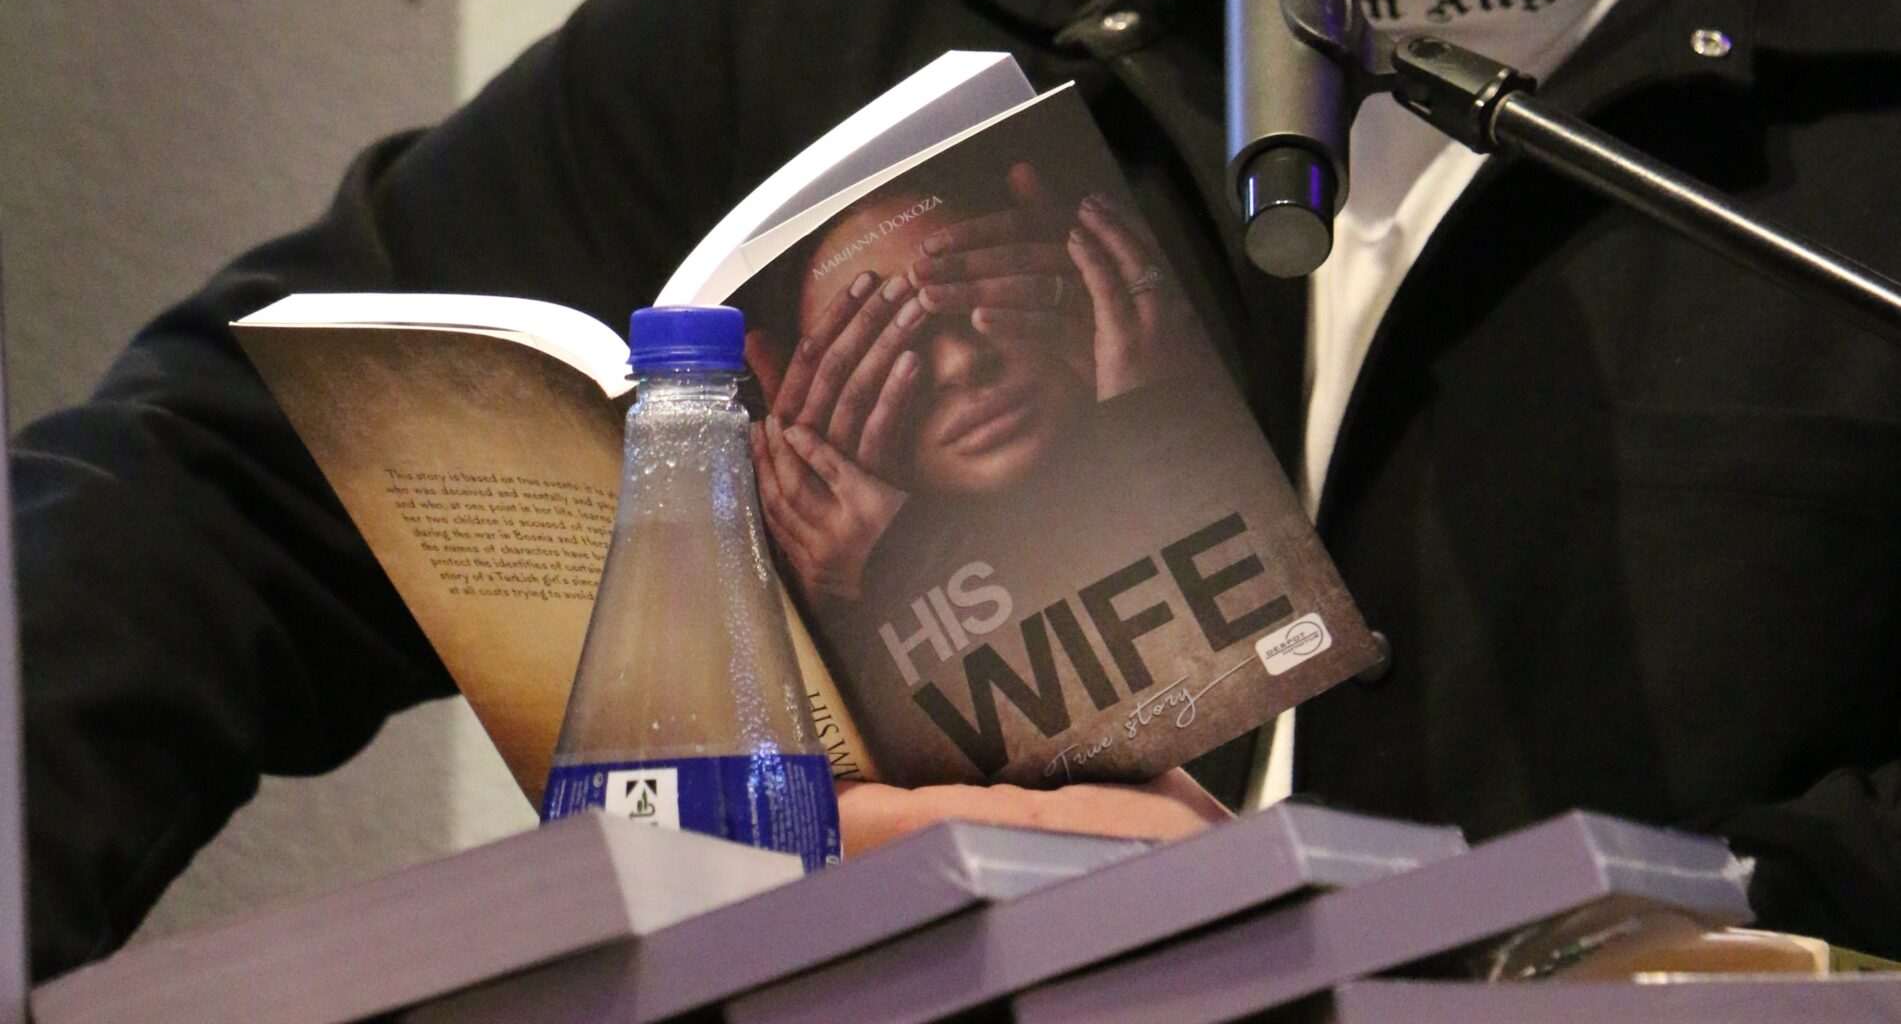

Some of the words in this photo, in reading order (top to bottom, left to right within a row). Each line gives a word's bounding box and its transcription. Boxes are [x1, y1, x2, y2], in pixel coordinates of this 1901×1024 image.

[812, 231, 879, 280] MARIJANA
[879, 195, 943, 236] DOKOZA
[384, 469, 413, 480] This
[416, 473, 446, 487] story
[447, 472, 460, 482] is
[461, 472, 497, 483] based
[500, 476, 514, 484] on
[516, 476, 540, 486] true
[385, 485, 408, 495] who
[415, 488, 436, 496] was
[441, 485, 493, 497] deceived
[498, 488, 517, 498] and
[523, 490, 568, 506] mentally
[572, 495, 592, 506] and
[395, 498, 415, 508] and
[450, 501, 462, 510] at
[465, 503, 487, 511] one
[490, 502, 517, 514] point
[519, 502, 531, 513] in
[532, 503, 552, 514] her
[400, 513, 421, 522] her
[425, 515, 448, 524] two
[454, 514, 499, 526] children
[503, 516, 515, 527] is
[518, 519, 567, 530] accused
[570, 521, 583, 532] of
[452, 529, 470, 539] the
[475, 532, 495, 540] war
[498, 529, 511, 539] in
[512, 529, 553, 544] Bosnia
[557, 535, 577, 545] and
[421, 542, 440, 552] the
[444, 544, 480, 554] names
[484, 543, 495, 553] of
[500, 544, 560, 557] characters
[562, 548, 590, 559] have
[430, 557, 471, 569] protect
[473, 558, 493, 569] the
[495, 558, 548, 570] identities
[549, 560, 562, 571] of
[440, 572, 469, 584] story
[472, 571, 484, 582] of
[494, 571, 538, 584] Turkish
[449, 587, 460, 596] at
[463, 586, 476, 596] all
[478, 587, 510, 598] costs
[511, 589, 548, 602] trying
[547, 590, 561, 600] to
[878, 560, 1013, 686] HIS
[912, 511, 1295, 778] WIFE
[1043, 737, 1113, 784] True
[1125, 670, 1222, 738] story
[825, 738, 861, 779] WI
